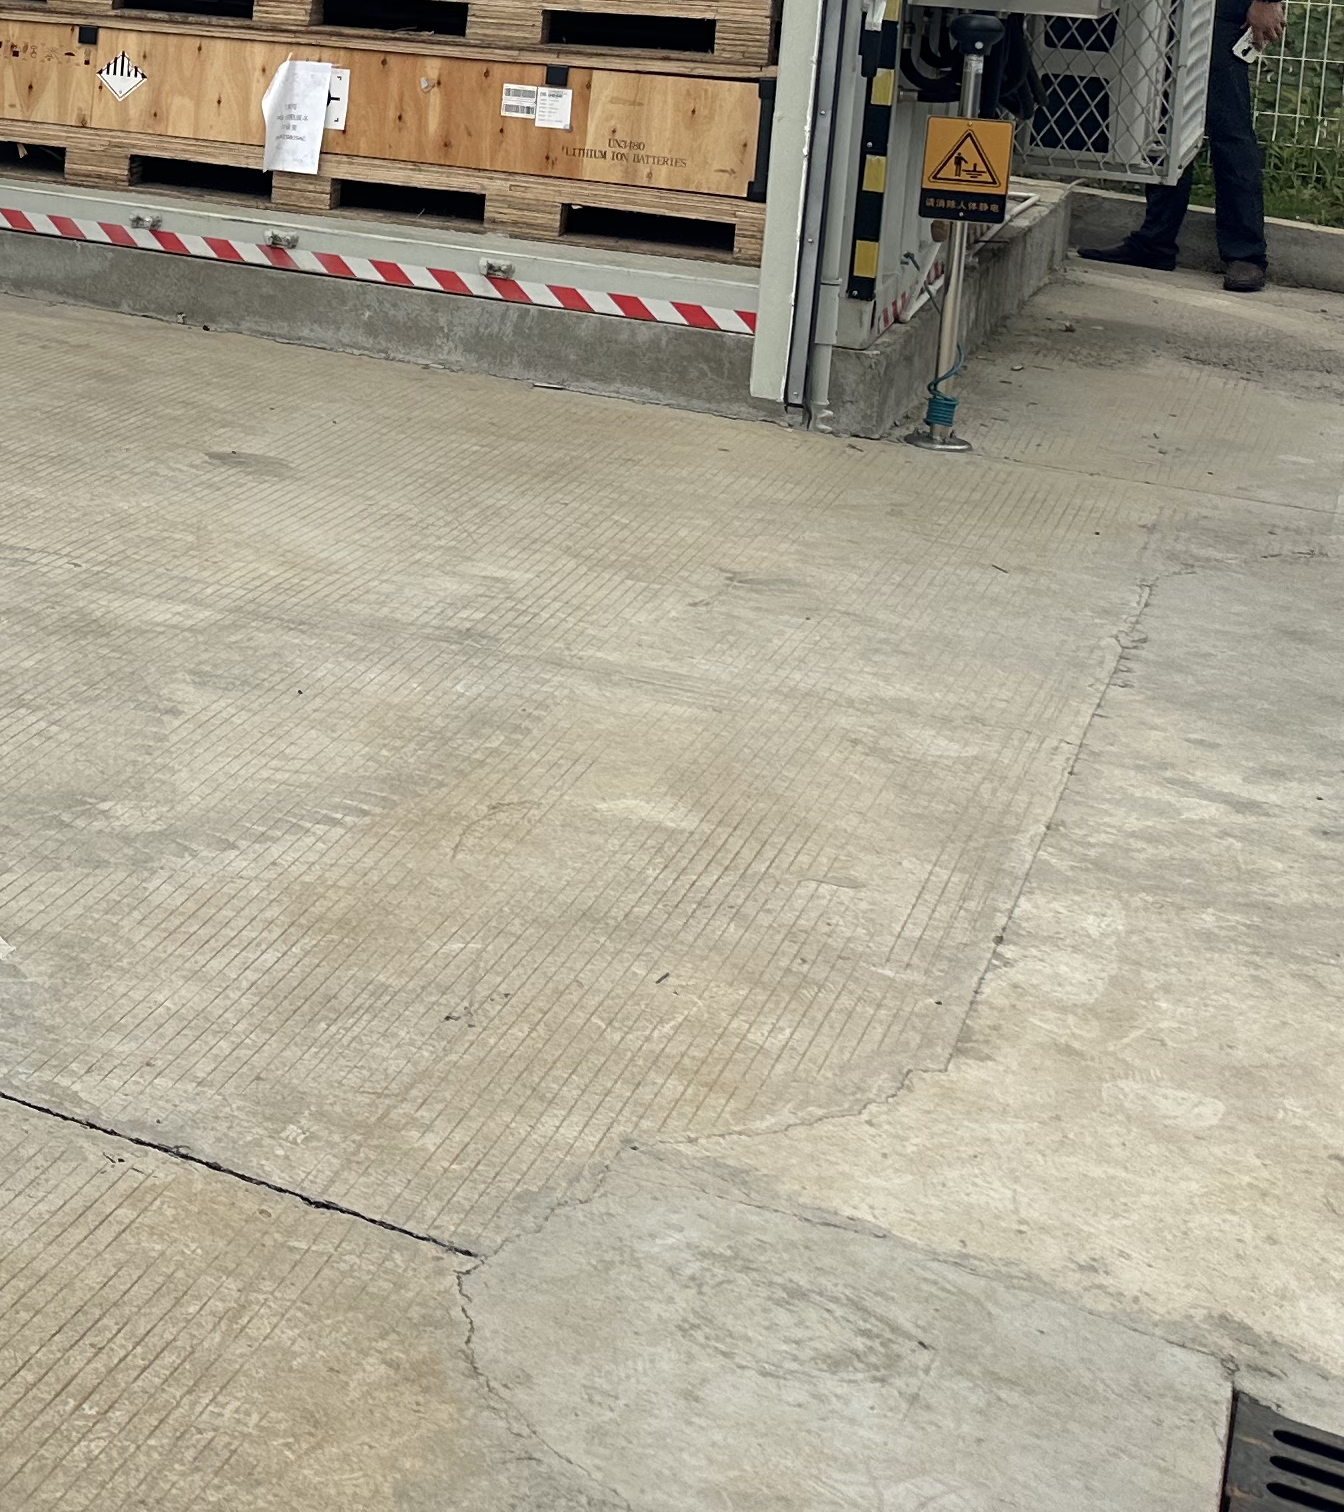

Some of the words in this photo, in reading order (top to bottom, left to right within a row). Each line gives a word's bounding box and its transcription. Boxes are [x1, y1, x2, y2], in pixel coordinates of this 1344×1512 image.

[565, 146, 608, 161] LITHIUM
[611, 151, 629, 162] ION
[632, 154, 688, 168] BATTERIES
[925, 197, 1000, 213] 请消除人体静电
